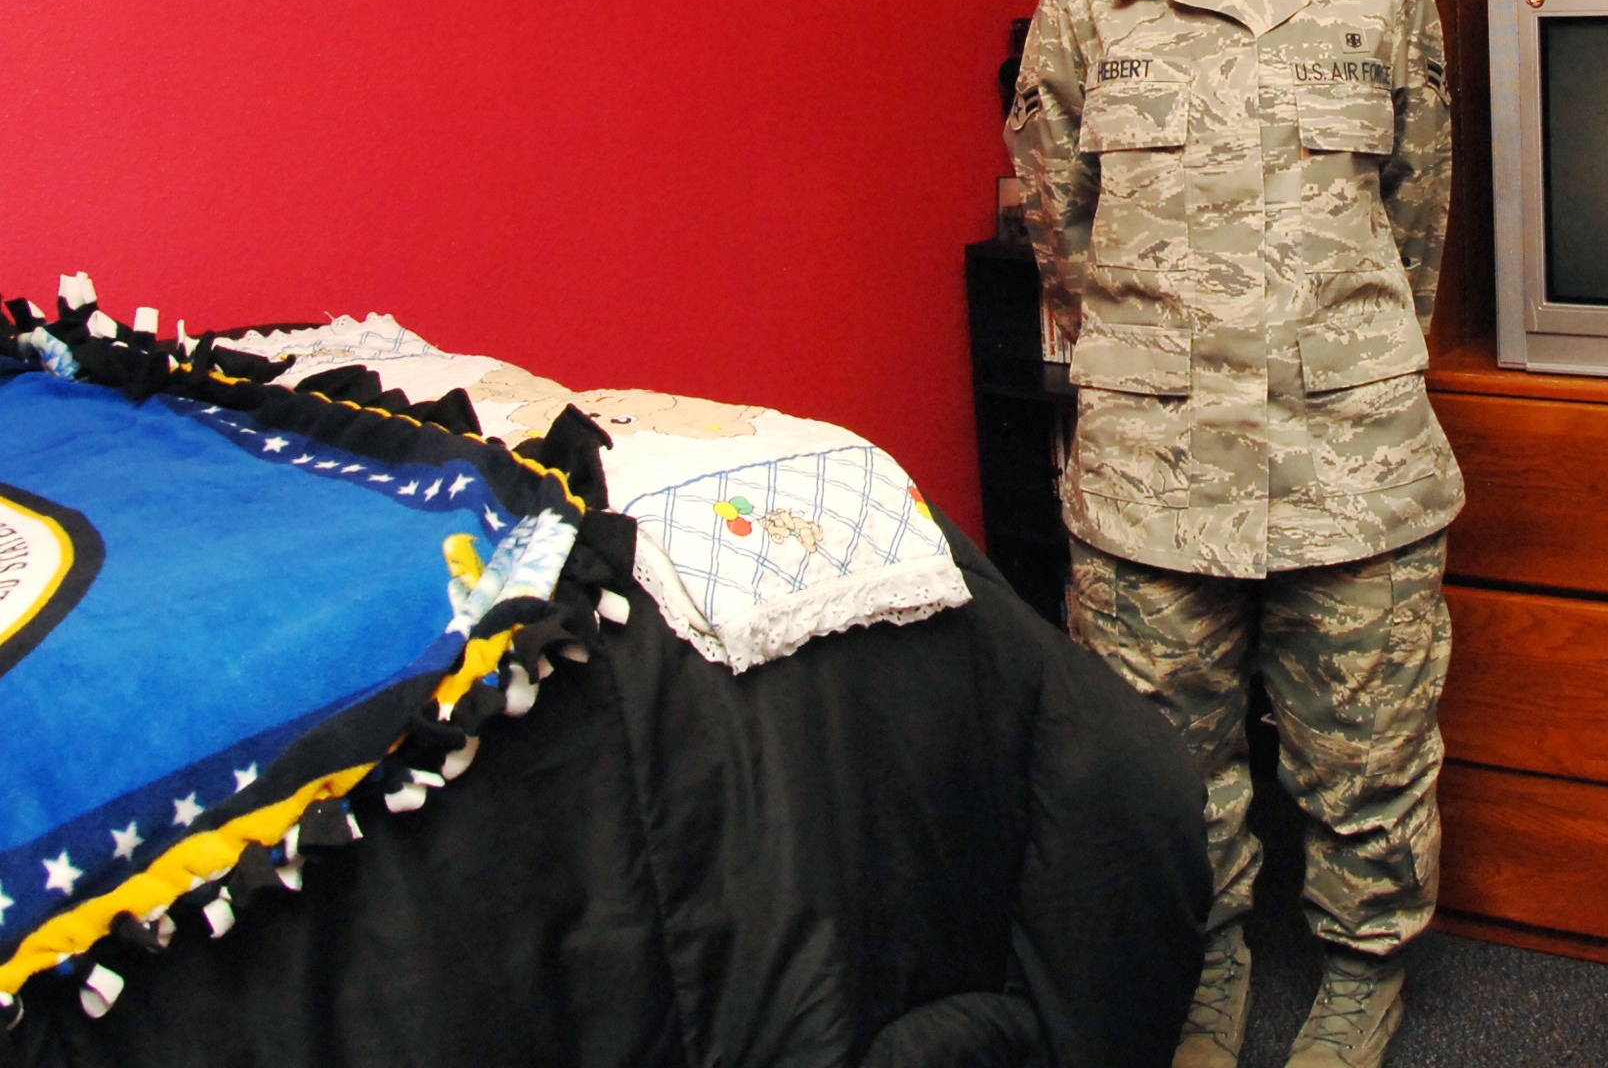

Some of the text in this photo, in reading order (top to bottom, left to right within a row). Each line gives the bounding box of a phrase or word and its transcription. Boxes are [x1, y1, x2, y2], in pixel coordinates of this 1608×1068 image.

[1097, 59, 1154, 83] HEBERT
[1295, 63, 1328, 81] U.S.
[1332, 62, 1360, 81] AIR
